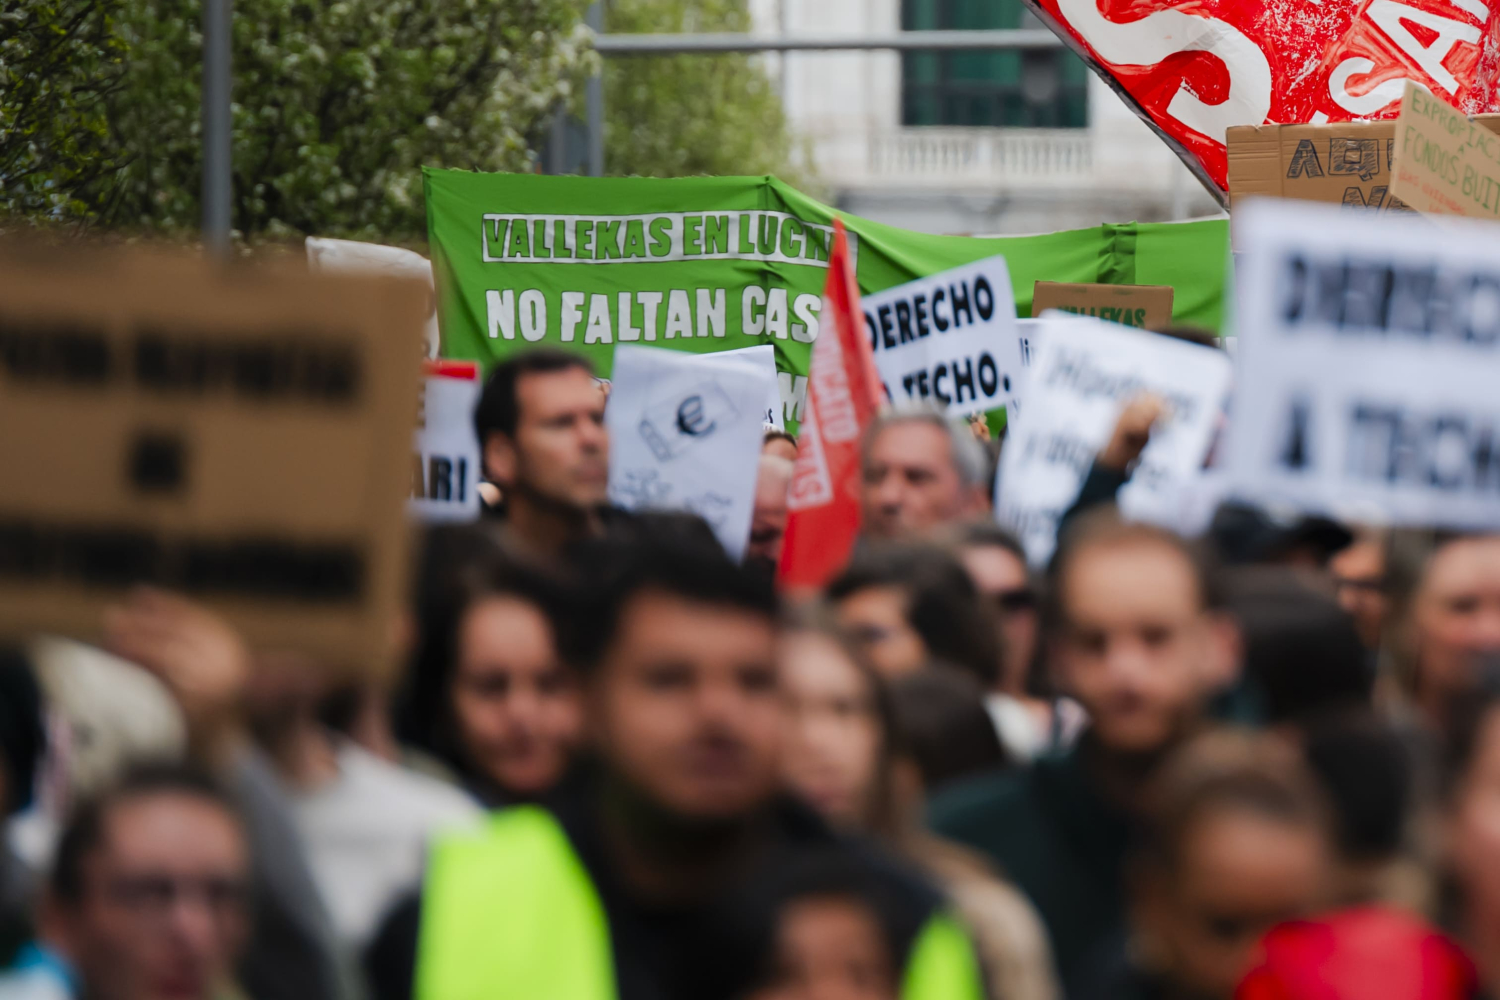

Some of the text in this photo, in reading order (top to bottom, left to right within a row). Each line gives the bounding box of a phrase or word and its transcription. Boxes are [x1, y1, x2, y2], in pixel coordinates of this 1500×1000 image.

[484, 213, 832, 263] VALLEKAS EN LUCH
[485, 285, 822, 344] NO FALTAN CAS
